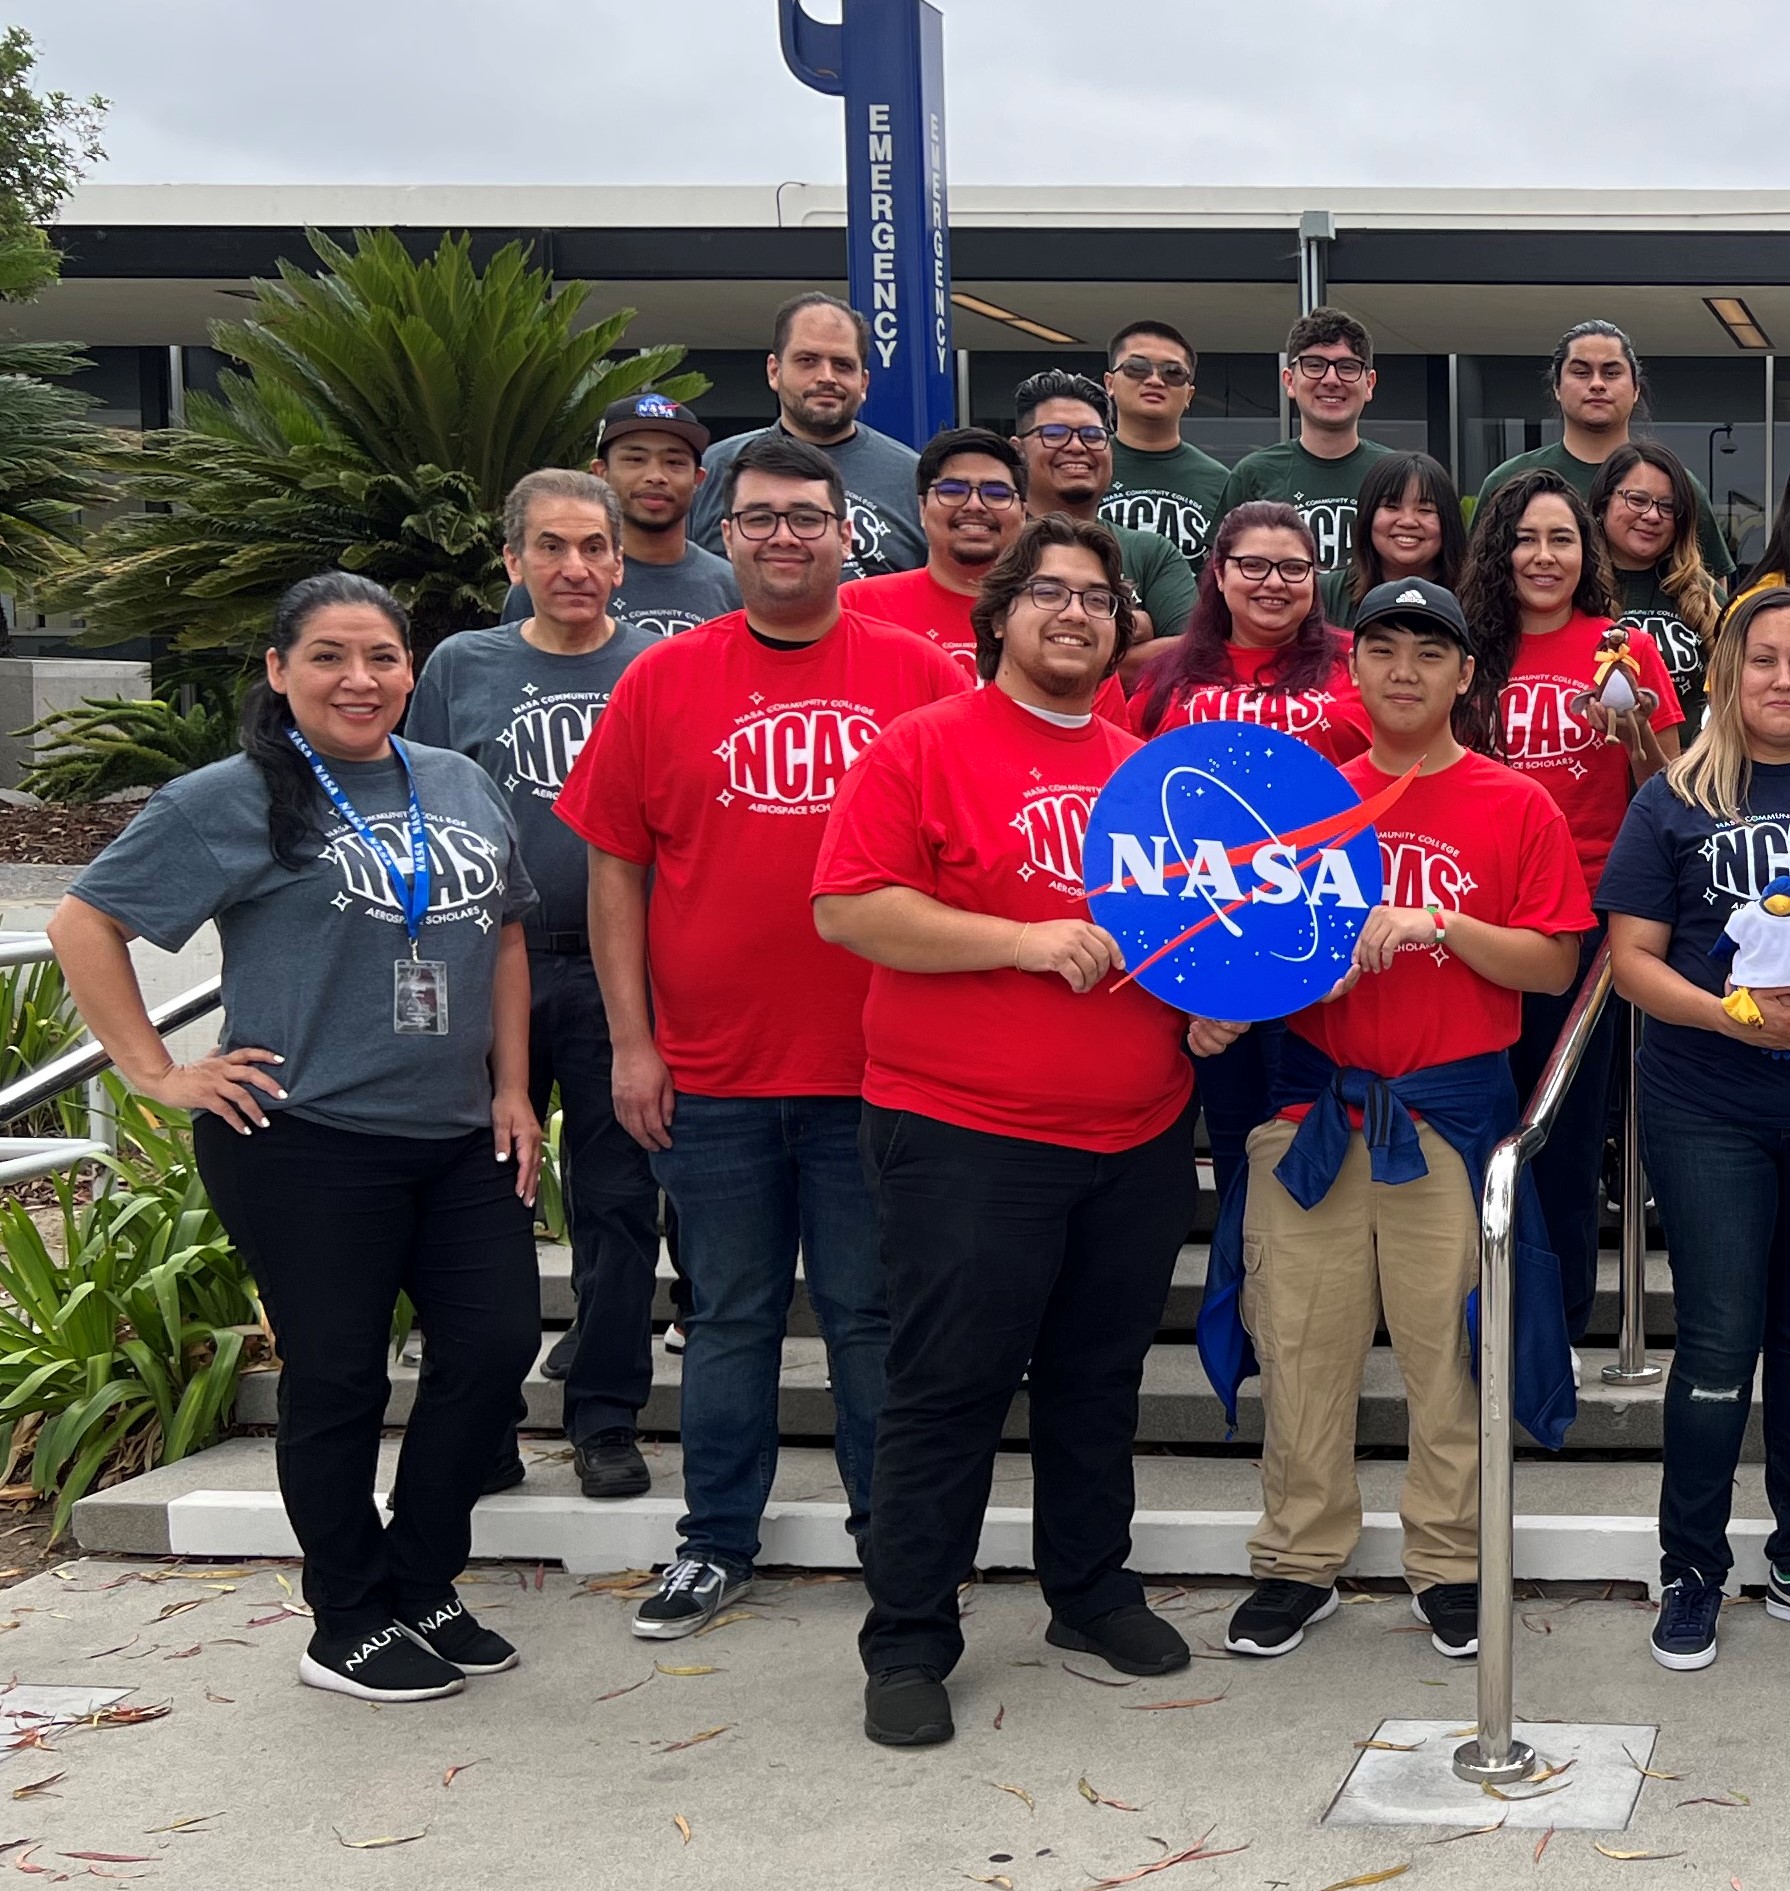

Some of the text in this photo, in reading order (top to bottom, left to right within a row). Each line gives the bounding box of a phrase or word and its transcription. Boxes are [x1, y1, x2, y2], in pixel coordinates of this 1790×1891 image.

[868, 104, 897, 368] EMERGENCY
[930, 113, 946, 373] EMERGENCY
[640, 404, 674, 418] NASA
[1125, 489, 1170, 497] COMMUNITY
[629, 609, 682, 618] COMMUNITY
[512, 699, 540, 715] NASA
[540, 692, 600, 705] COMMUNITY
[733, 699, 875, 726] NASA COMMUNITY COLLEGE
[1498, 683, 1596, 760] CAS
[288, 730, 312, 758] NASA
[511, 703, 608, 787] NC
[1526, 757, 1574, 770] SCHOLARS
[313, 764, 338, 796] NASA
[1023, 784, 1102, 799] NASA COMMUNITY
[339, 801, 365, 831] NASA
[409, 803, 423, 835] NASA
[748, 803, 808, 815] AEROSPACE
[1022, 793, 1100, 886] NC
[1377, 831, 1460, 858] MUNITY COLLEGE
[414, 841, 427, 872] NASA
[1106, 833, 1369, 909] NASA
[1378, 841, 1462, 913] AS
[1048, 881, 1085, 897] AEROS
[365, 905, 480, 926] AEROSP SCHOLARS
